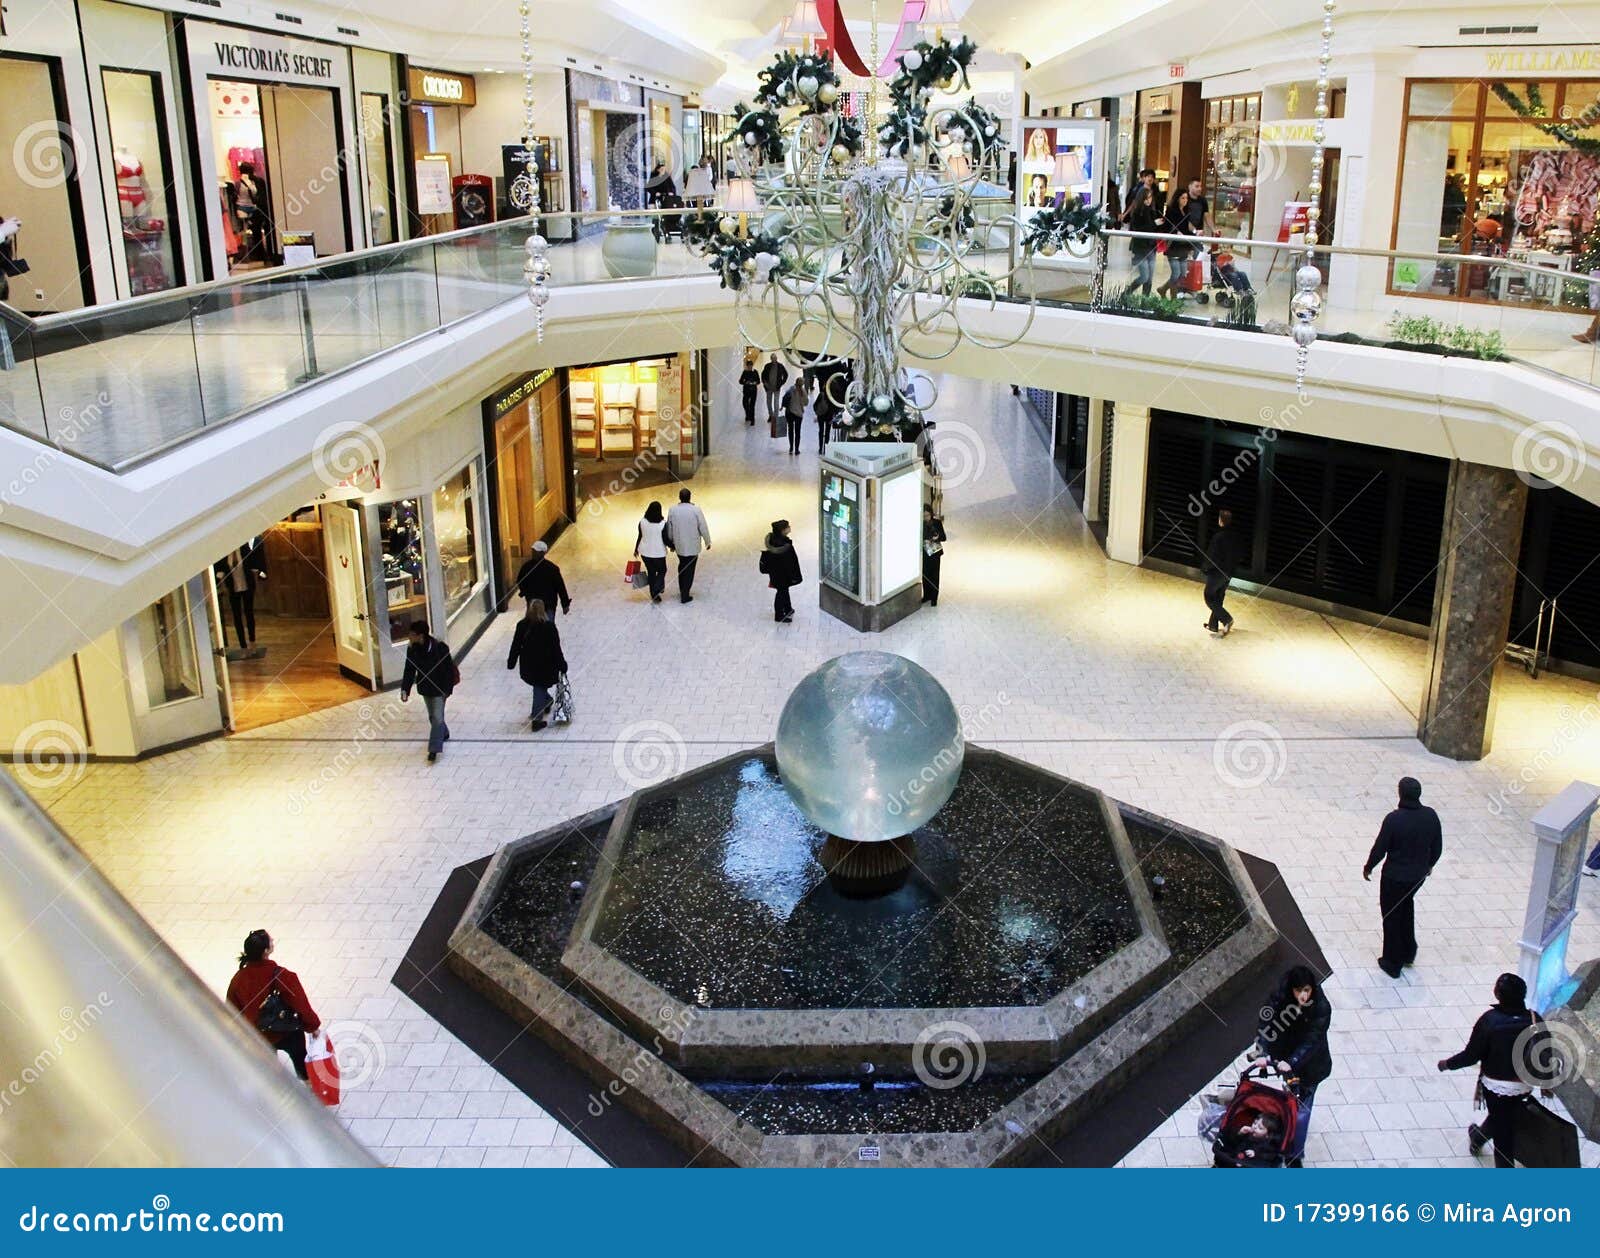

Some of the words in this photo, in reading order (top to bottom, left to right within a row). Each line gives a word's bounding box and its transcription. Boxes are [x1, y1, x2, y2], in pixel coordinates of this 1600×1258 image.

[215, 42, 290, 73] VICTORIA'S
[293, 54, 332, 78] SECRET
[1170, 65, 1184, 77] EXIT
